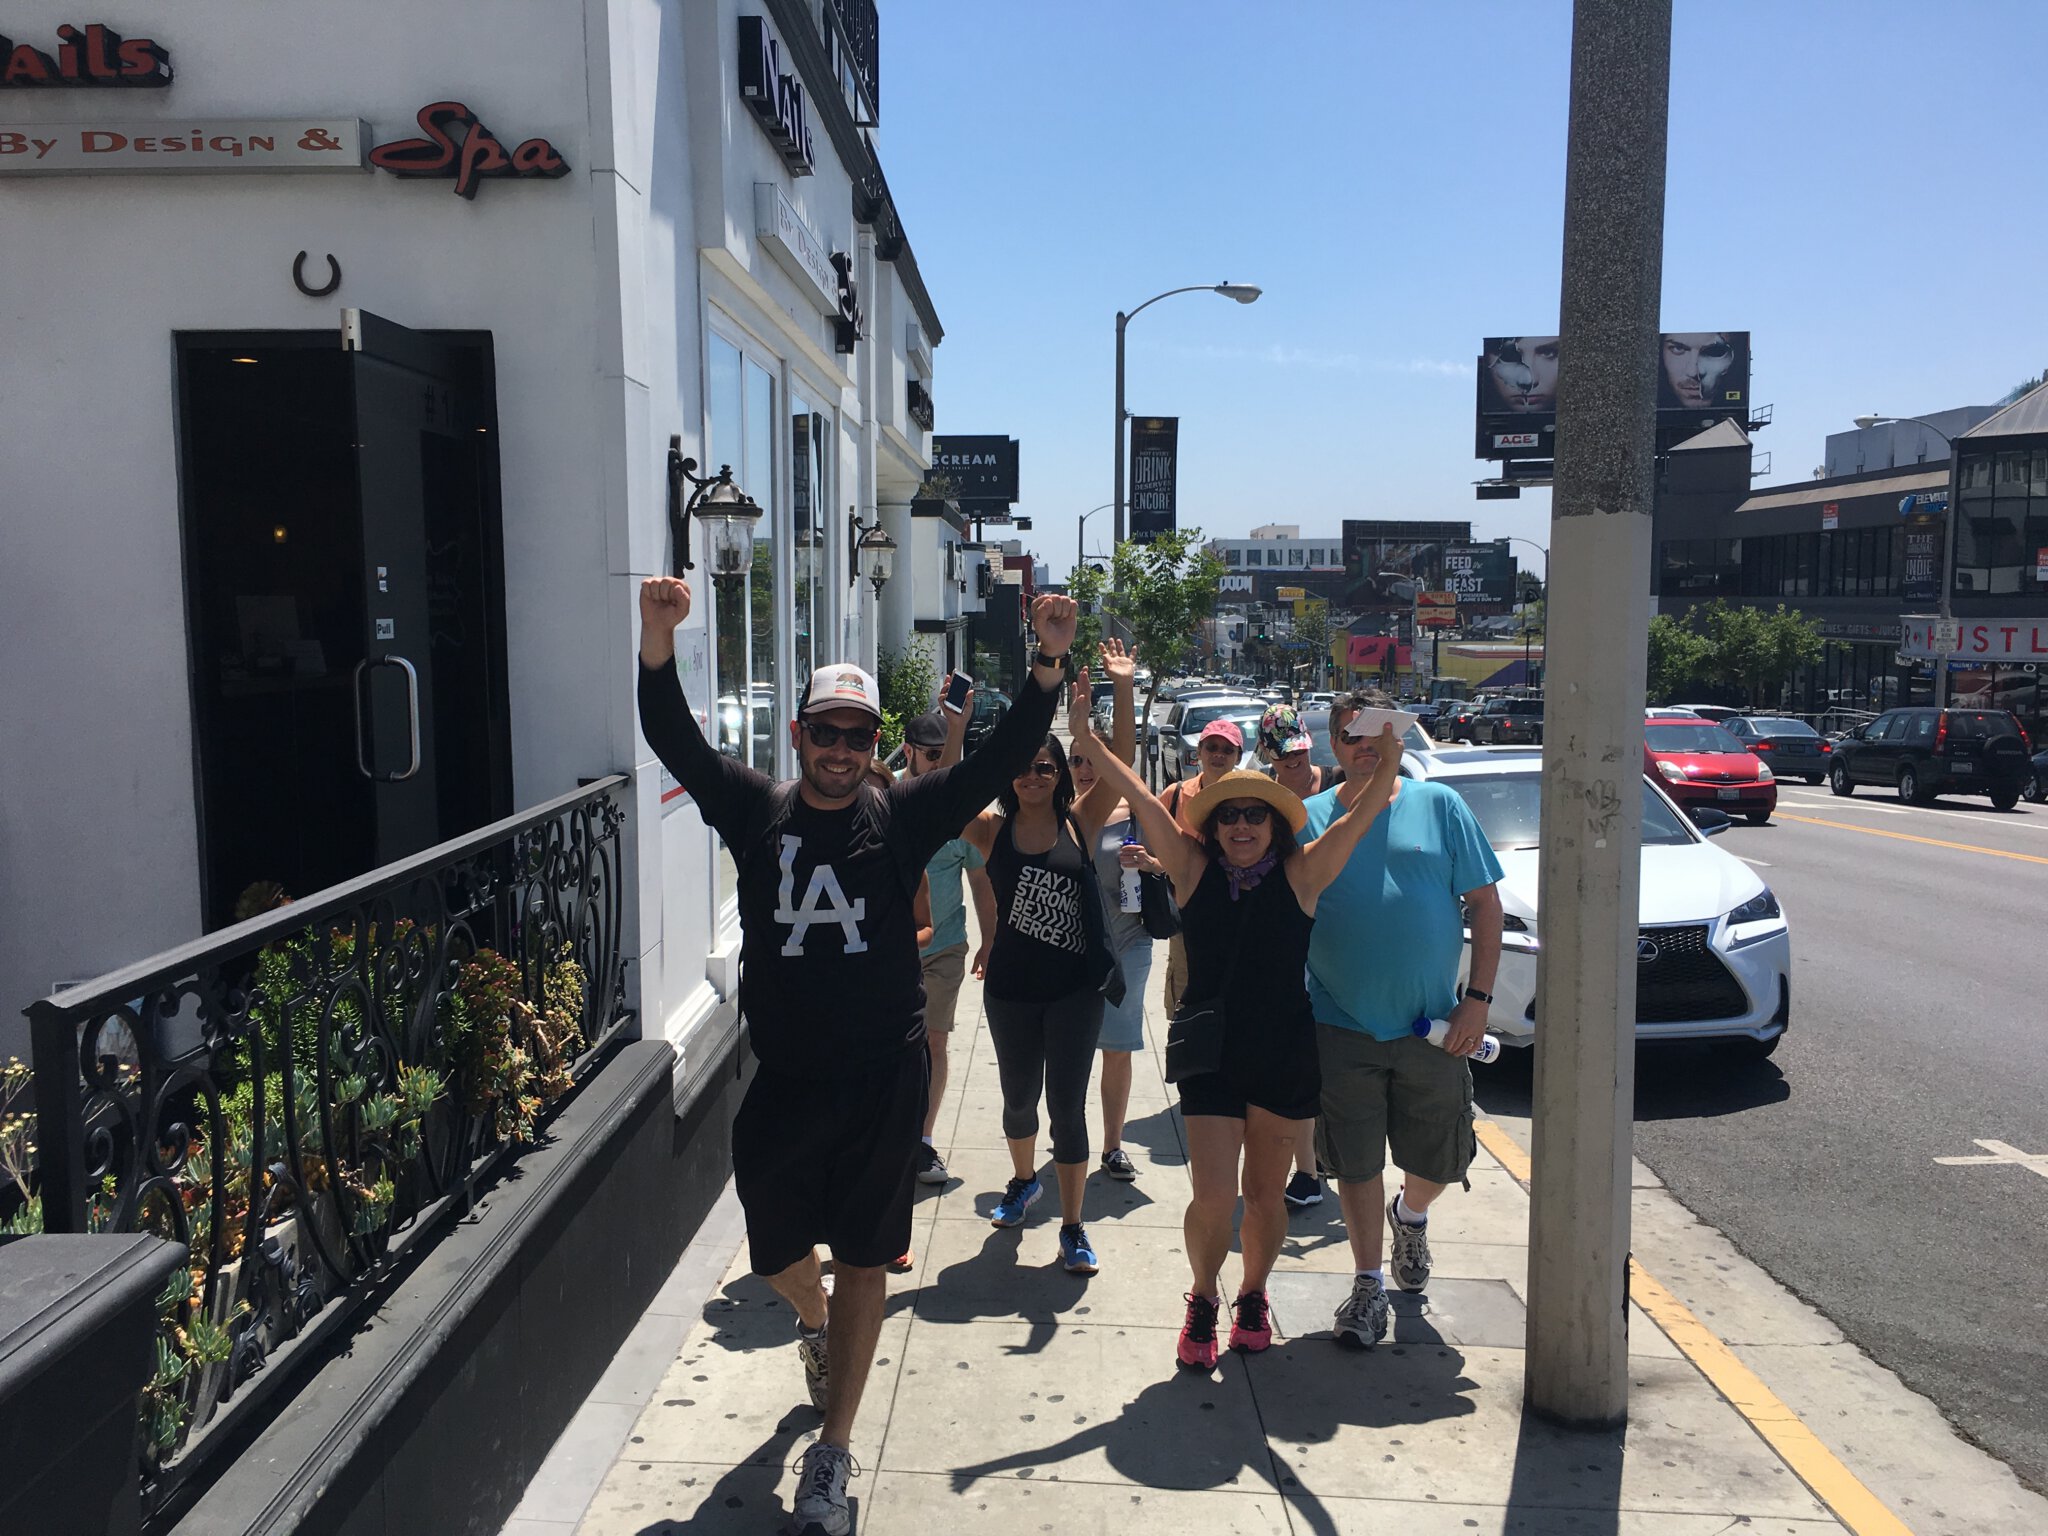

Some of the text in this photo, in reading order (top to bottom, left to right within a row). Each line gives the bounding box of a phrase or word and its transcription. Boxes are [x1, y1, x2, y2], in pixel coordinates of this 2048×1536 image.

[0, 23, 166, 84] ails
[297, 127, 343, 151] &
[369, 101, 568, 199] Spa
[1501, 434, 1532, 444] ACE
[932, 454, 997, 466] SCREAM
[1135, 456, 1172, 483] DRINK
[1134, 492, 1171, 510] ENCORE
[1907, 534, 1934, 544] THE
[1445, 556, 1472, 570] FEED
[1906, 559, 1933, 576] INDIE
[1219, 575, 1253, 594] DOOM
[1445, 577, 1484, 592] BEAST
[377, 623, 391, 634] Pull
[1019, 865, 1065, 891] STAY
[773, 833, 868, 957] LA
[1014, 881, 1079, 916] STRONG
[1011, 896, 1036, 914] BE
[1007, 909, 1066, 947] FIERCE
